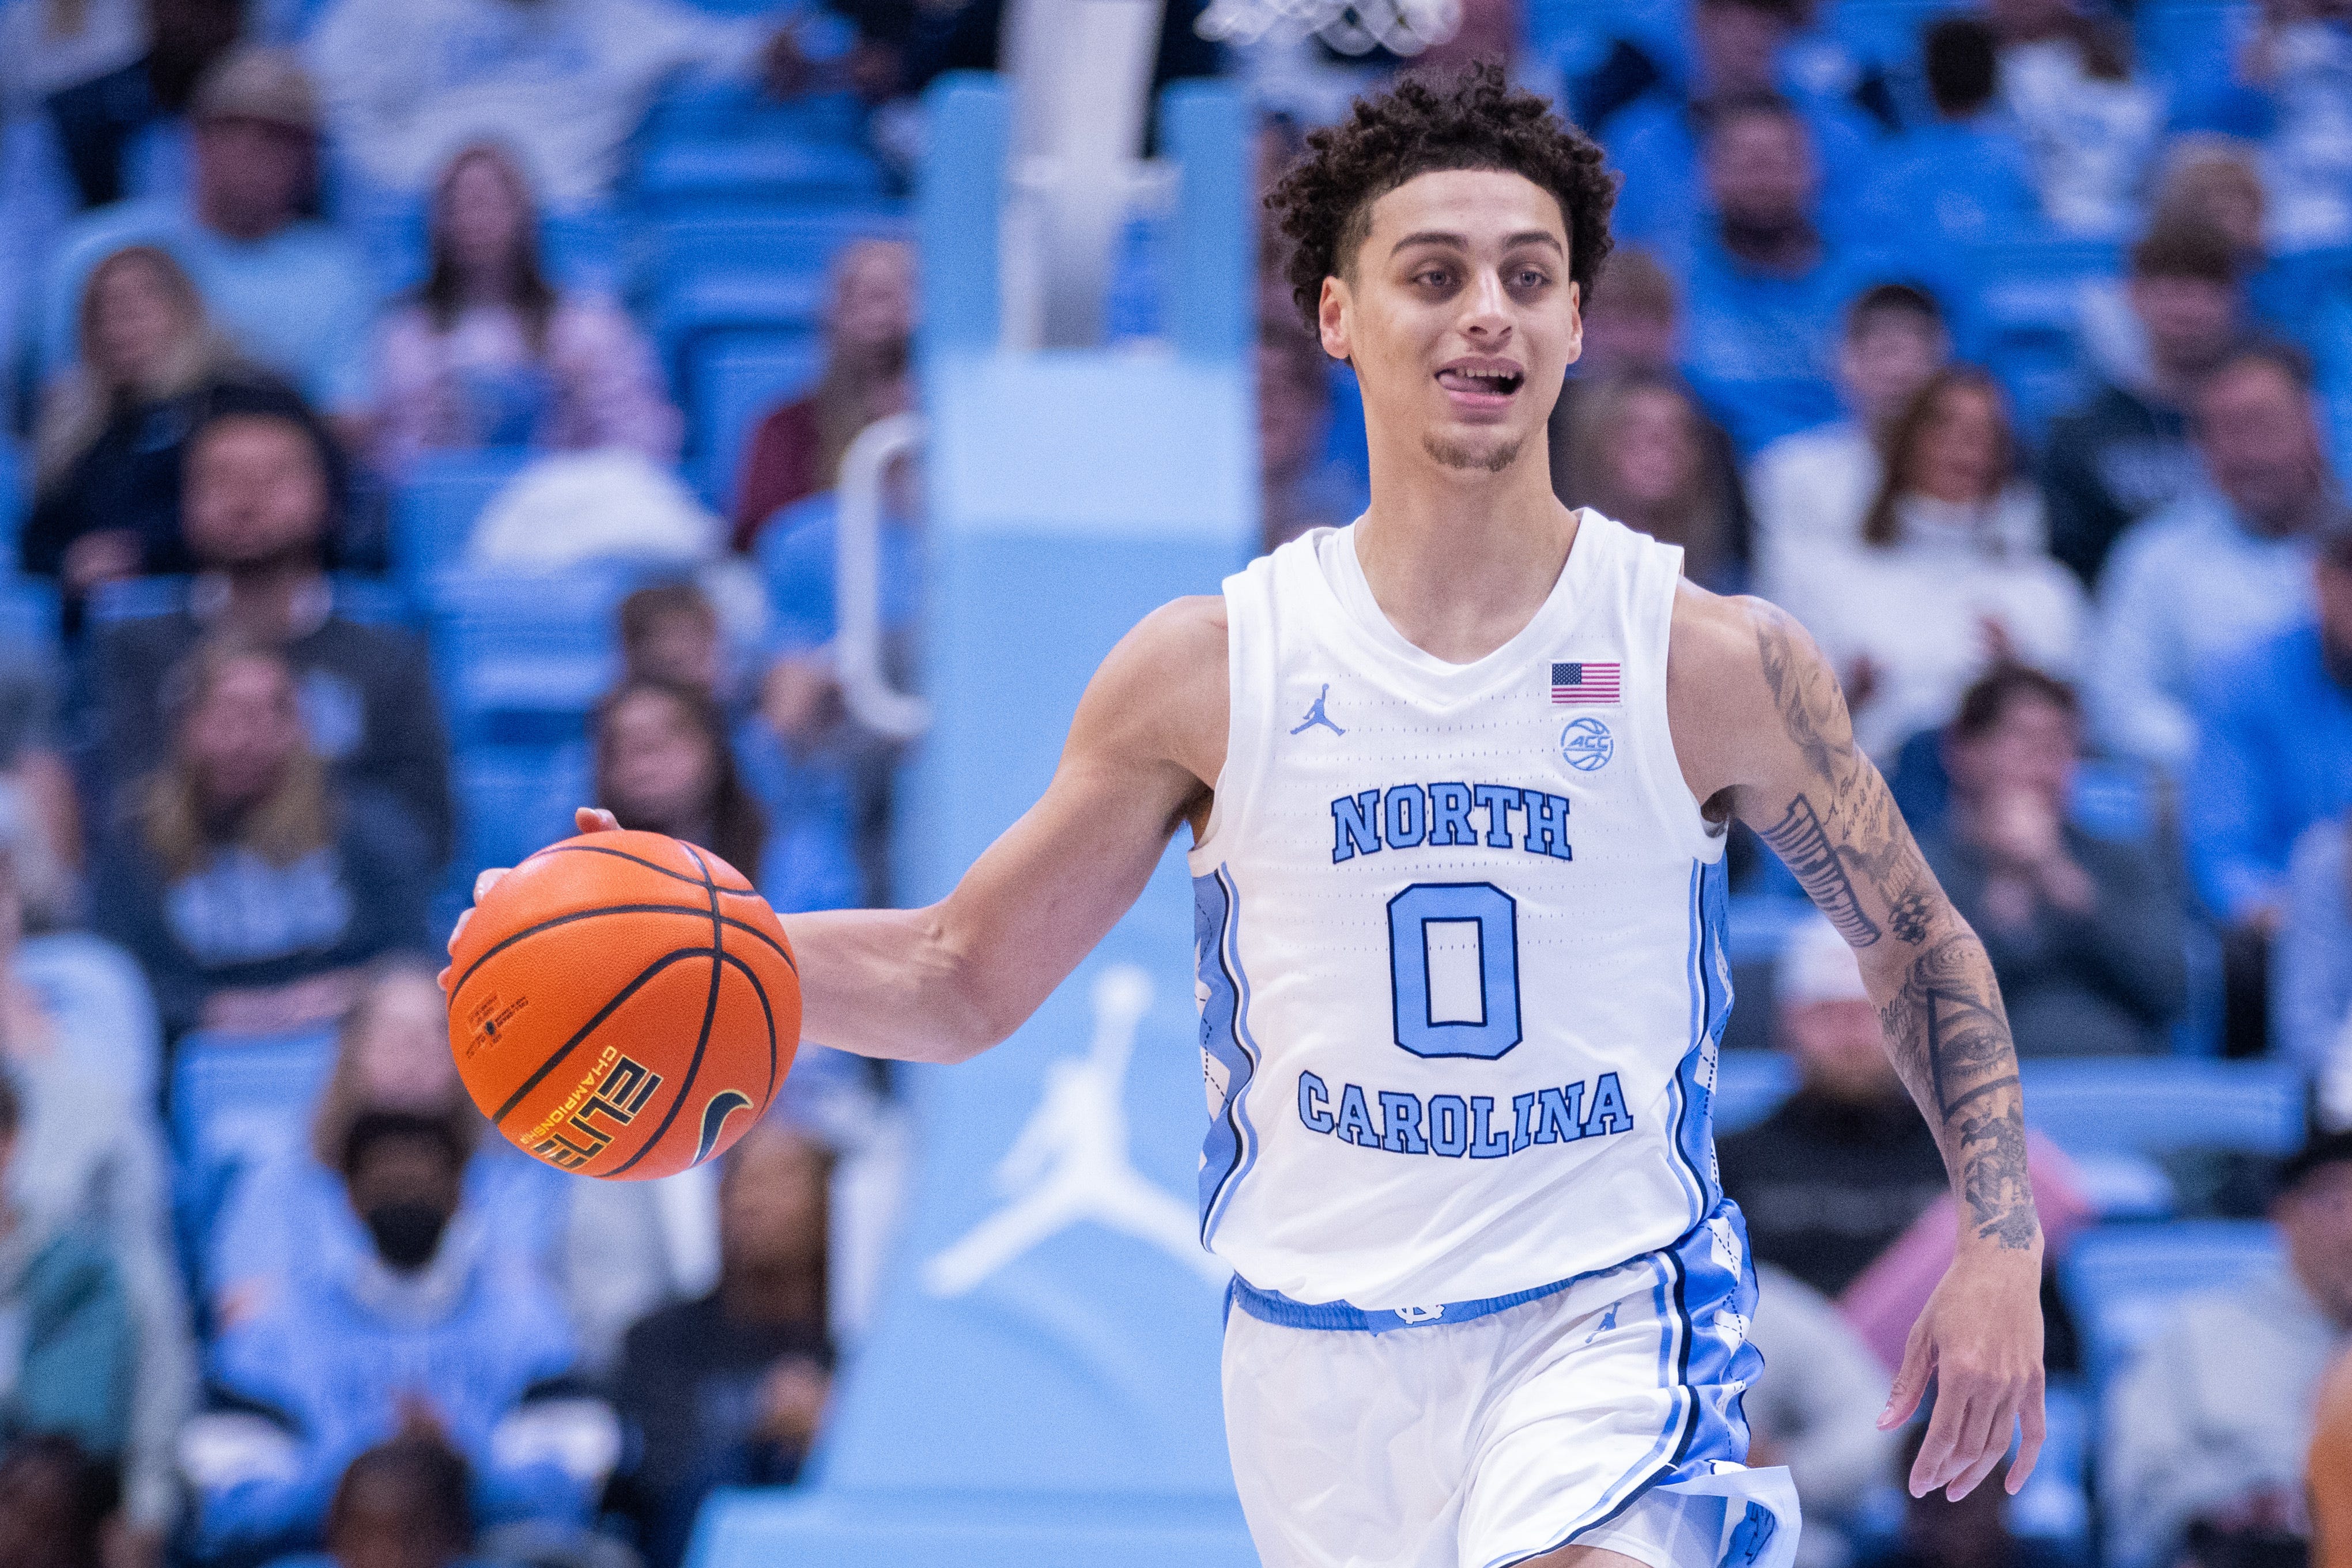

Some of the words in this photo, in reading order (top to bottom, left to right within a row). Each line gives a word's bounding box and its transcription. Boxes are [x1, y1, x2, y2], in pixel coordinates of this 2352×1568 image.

[1568, 735, 1612, 749] ACC
[1331, 782, 1573, 864] NORTH
[1387, 882, 1523, 1060] 0
[530, 1054, 664, 1170] ELITE
[1298, 1070, 1633, 1159] CAROLINA
